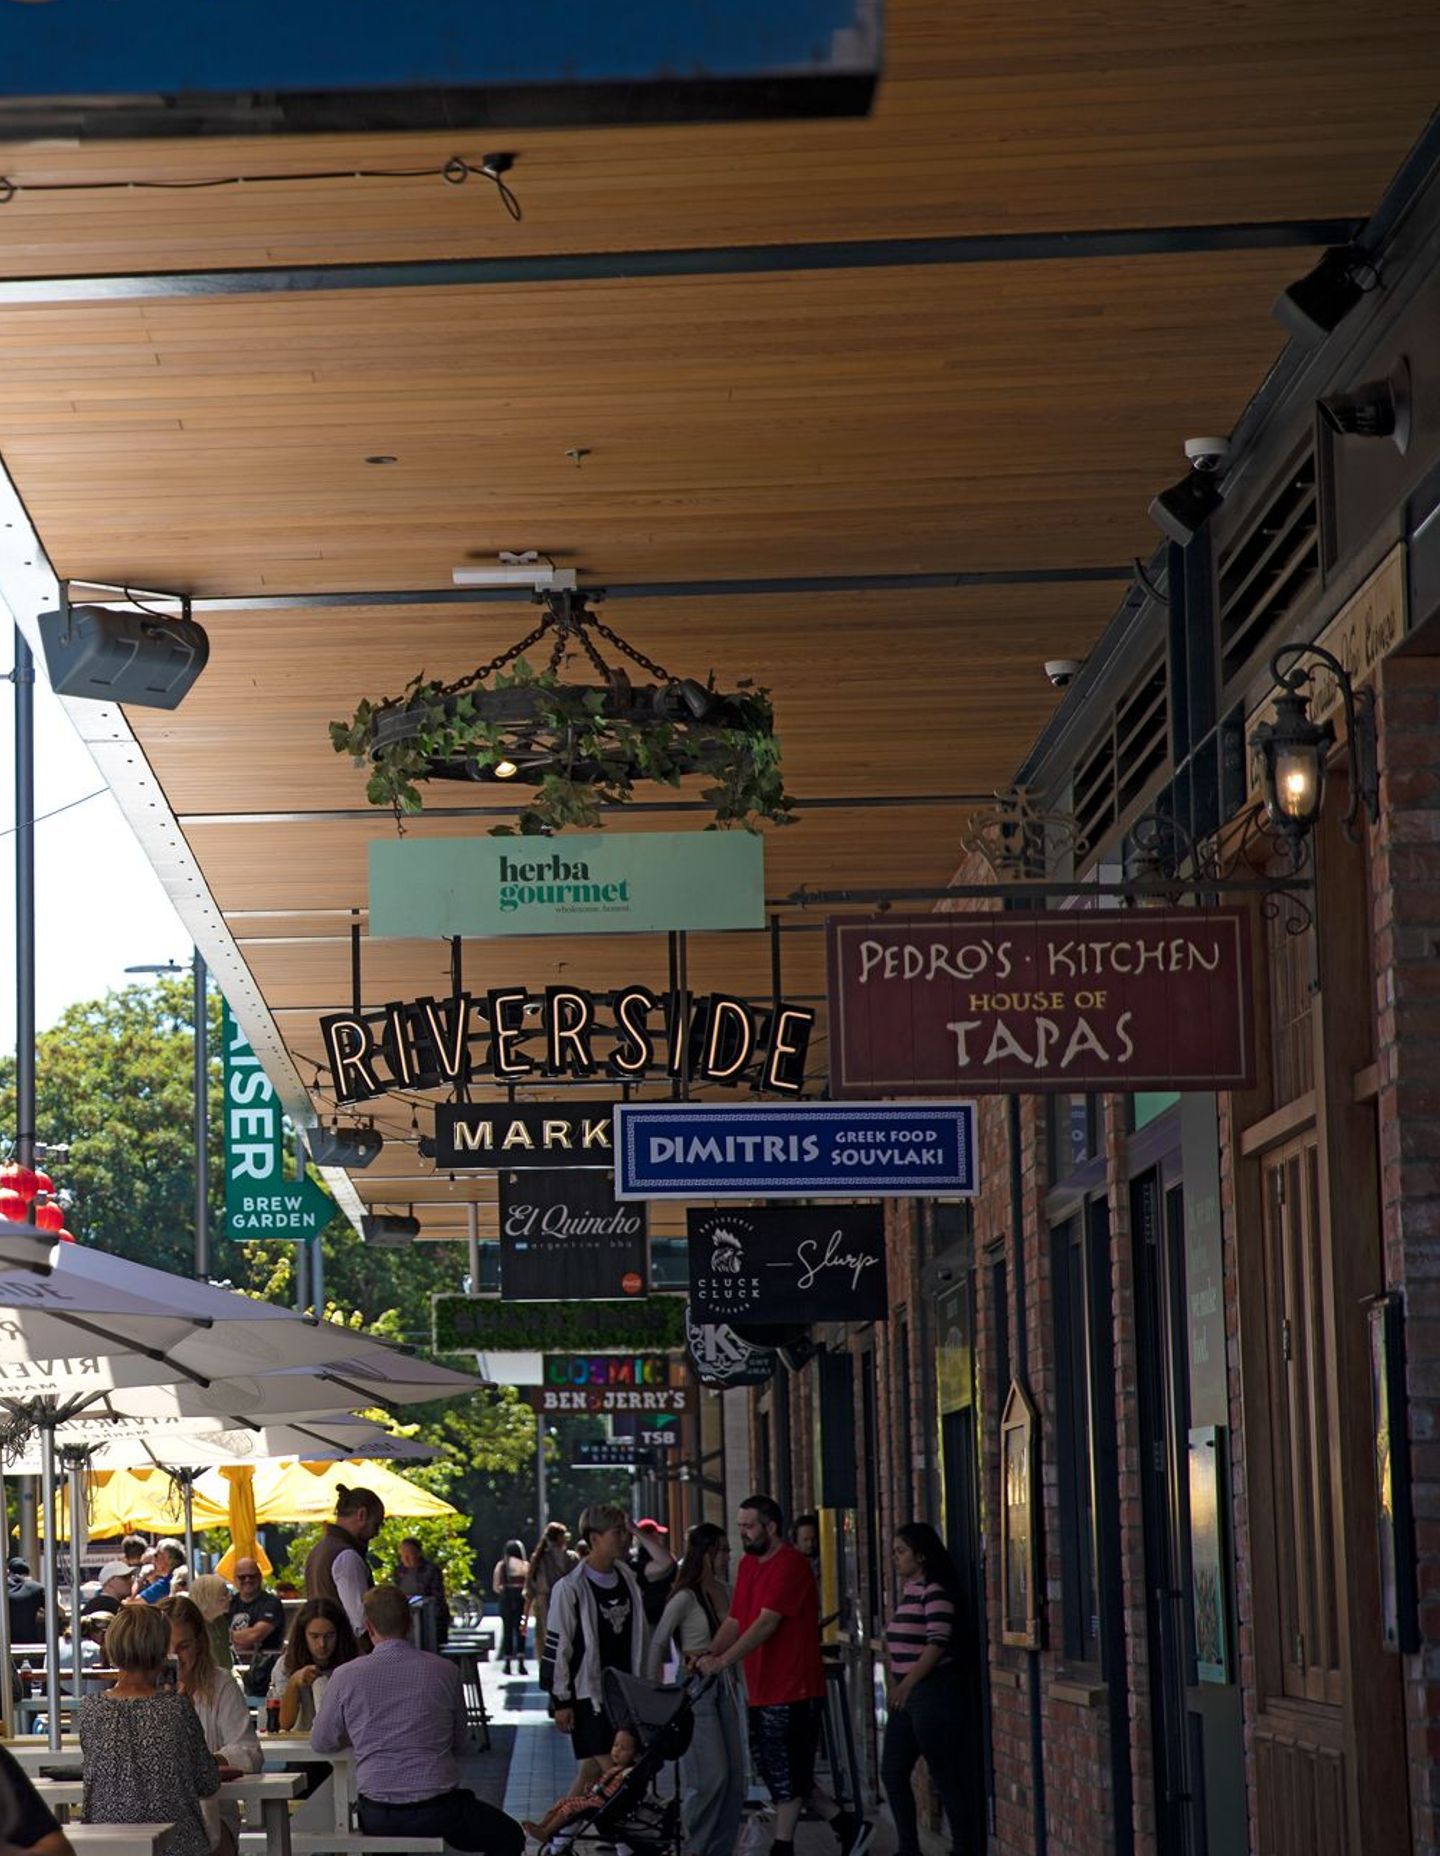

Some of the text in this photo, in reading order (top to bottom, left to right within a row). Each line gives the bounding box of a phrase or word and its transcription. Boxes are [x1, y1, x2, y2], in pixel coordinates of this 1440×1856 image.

[499, 854, 590, 883] herba
[499, 878, 631, 912] gourmet
[859, 938, 1220, 982] PEDRO'S KITCHEN
[969, 990, 1108, 1012] HOUSE OF
[321, 986, 816, 1104] RIVERSIDE
[946, 1012, 1133, 1069] TAPAS
[454, 1119, 613, 1149] MARK
[835, 1130, 938, 1143] GREEK FOOD
[649, 1134, 820, 1164] DIMITRIS
[831, 1148, 944, 1165] SOUVLAKI
[243, 1196, 303, 1212] BREW
[232, 1213, 316, 1228] GARDEN
[505, 1203, 642, 1239] El Quincho
[797, 1229, 880, 1291] Slurp
[698, 1278, 760, 1288] CLUCK
[698, 1289, 760, 1299] CLUCK
[548, 1358, 664, 1385] COSMIC
[544, 1391, 586, 1409] BEN
[603, 1389, 686, 1409] JERRY'S
[641, 1431, 676, 1445] TSB
